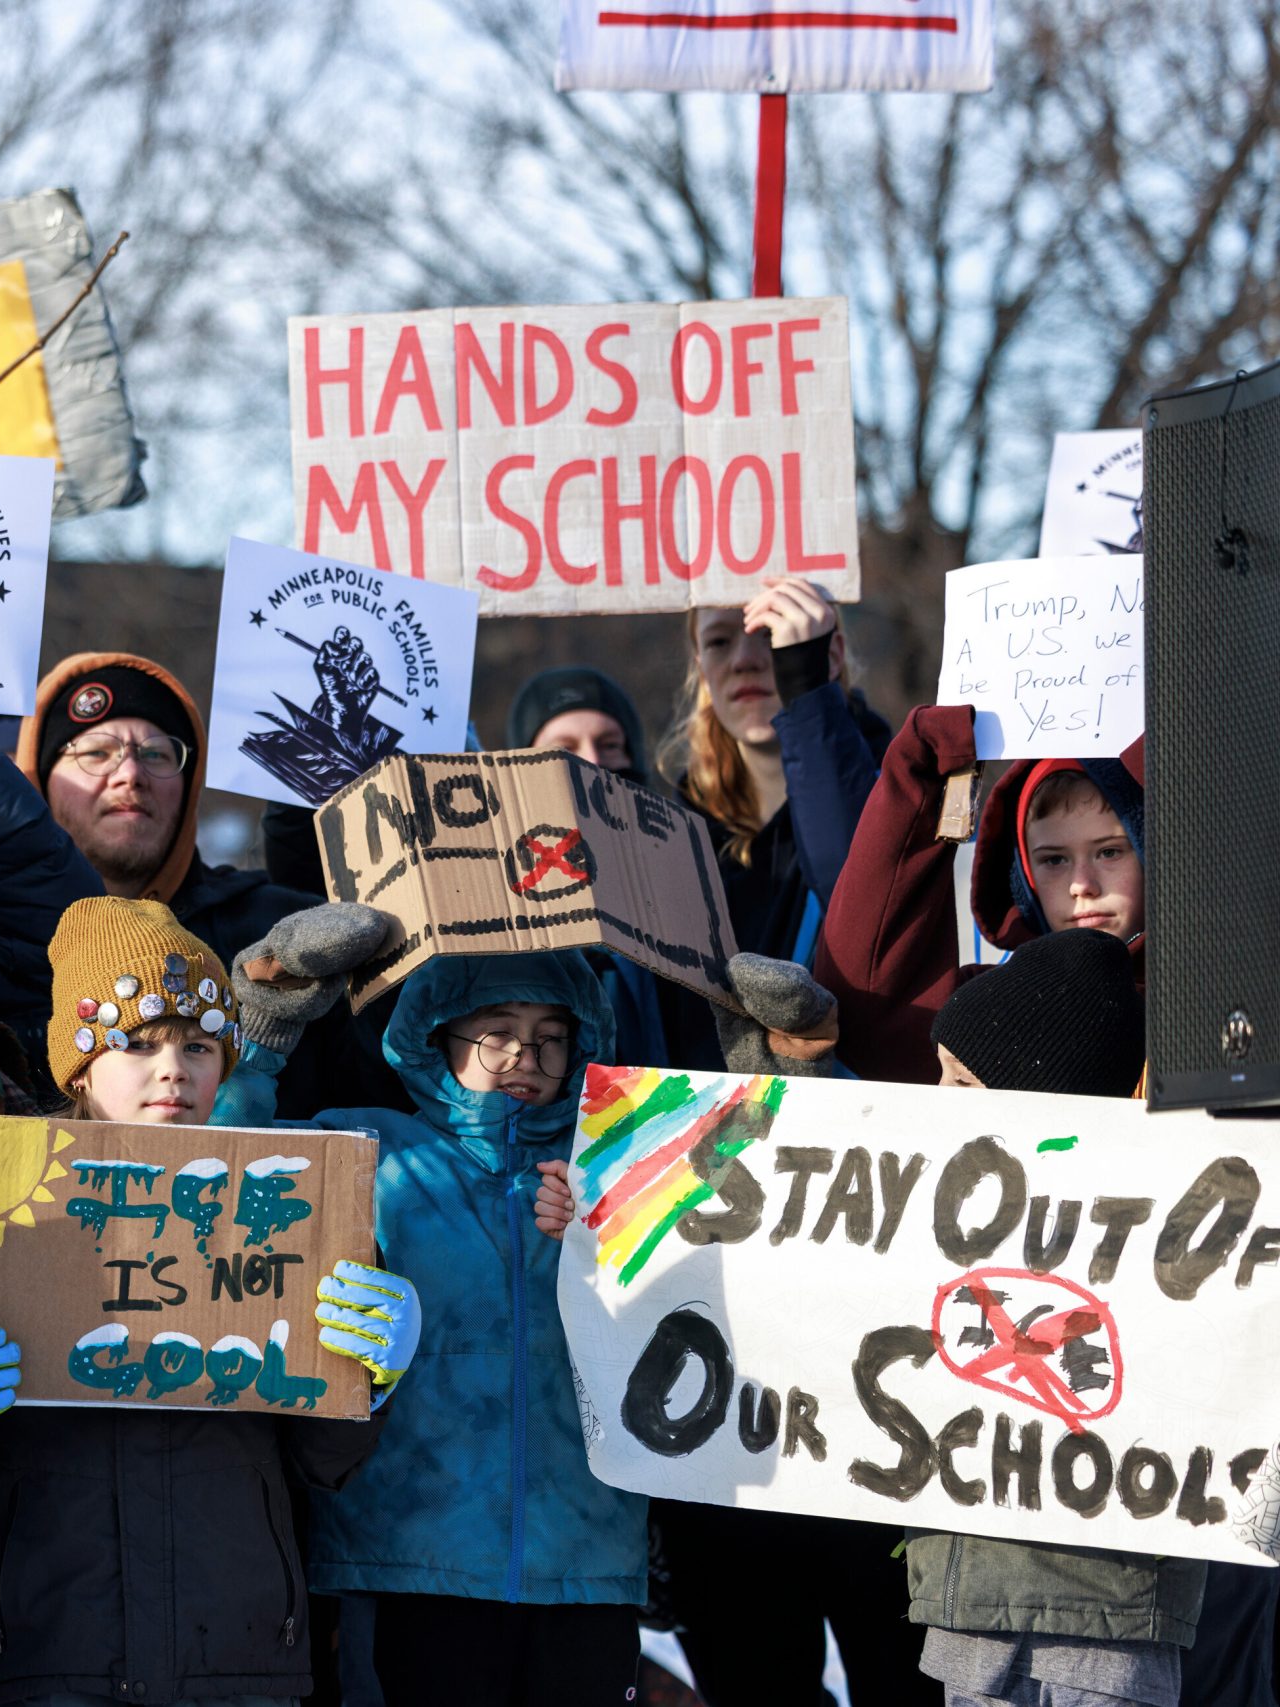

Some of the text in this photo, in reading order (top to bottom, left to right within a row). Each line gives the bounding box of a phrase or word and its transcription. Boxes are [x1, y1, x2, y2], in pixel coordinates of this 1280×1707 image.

[304, 318, 820, 439] HANDS OFF
[303, 451, 846, 592] MY SCHOOL
[267, 567, 439, 690] MINNEAPOLIS FAMILIES
[303, 589, 419, 698] FOR PUBLIC SCHOOLS
[956, 639, 972, 665] A
[967, 580, 1086, 625] Trump,
[959, 673, 991, 695] be
[1105, 664, 1140, 687] of
[1019, 693, 1104, 742] Yes!
[363, 757, 677, 866] NO ICE
[66, 1154, 312, 1248] ICE
[675, 1099, 1280, 1301] STAY OUT OF
[102, 1252, 304, 1311] IS NOT
[68, 1319, 328, 1410] COOL
[619, 1303, 827, 1462] OUR
[952, 1284, 1111, 1394] ICE
